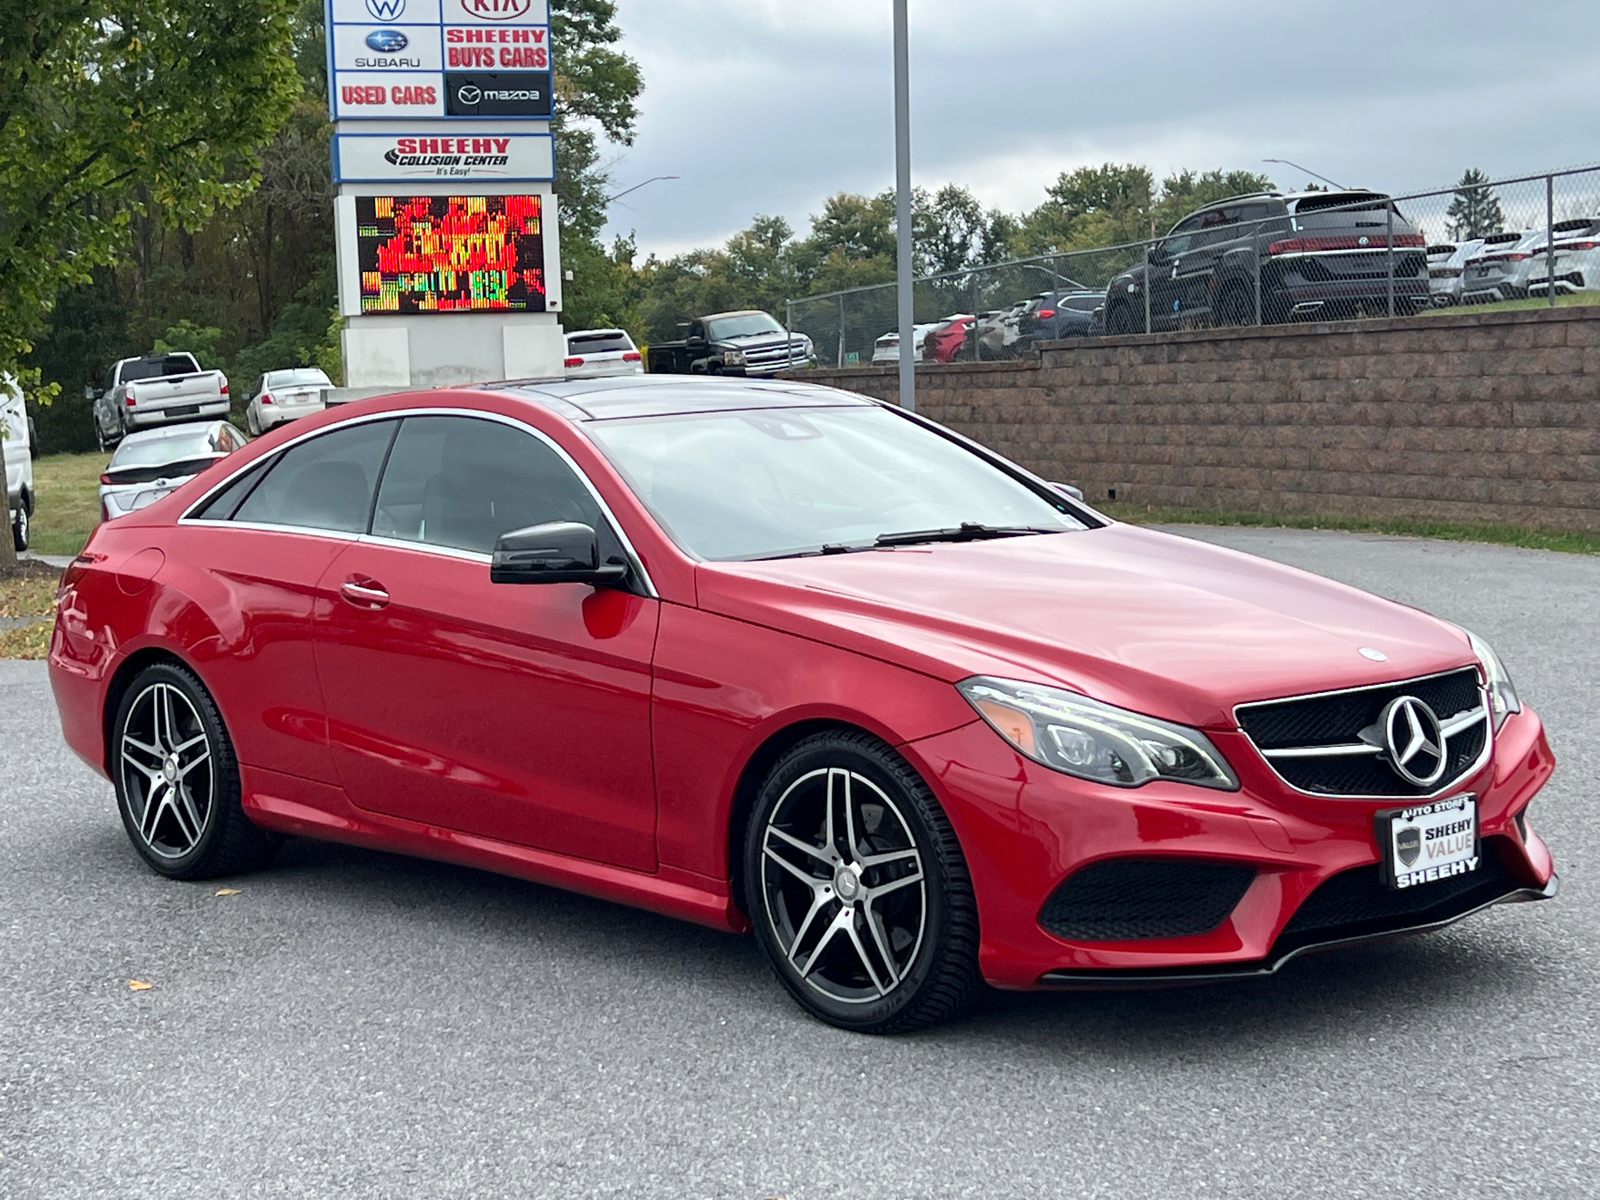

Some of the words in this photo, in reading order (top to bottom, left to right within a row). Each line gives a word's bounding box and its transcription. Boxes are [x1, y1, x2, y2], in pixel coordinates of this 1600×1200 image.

[446, 29, 546, 43] SHEEHY
[355, 58, 421, 67] SUBARU
[448, 47, 495, 67] BUYS
[500, 47, 548, 68] CARS
[342, 86, 387, 104] USED
[391, 86, 437, 105] CARS
[484, 90, 540, 100] mazda
[397, 138, 511, 154] SHEEHY
[399, 155, 460, 166] COLLISION
[463, 155, 509, 166] CENTER
[436, 167, 448, 175] It's
[449, 167, 471, 177] Easy!
[1401, 805, 1432, 819] AUTO
[1425, 817, 1472, 840] SHEEHY
[1426, 832, 1472, 859] VALUE
[1397, 856, 1479, 888] SHEEHY
